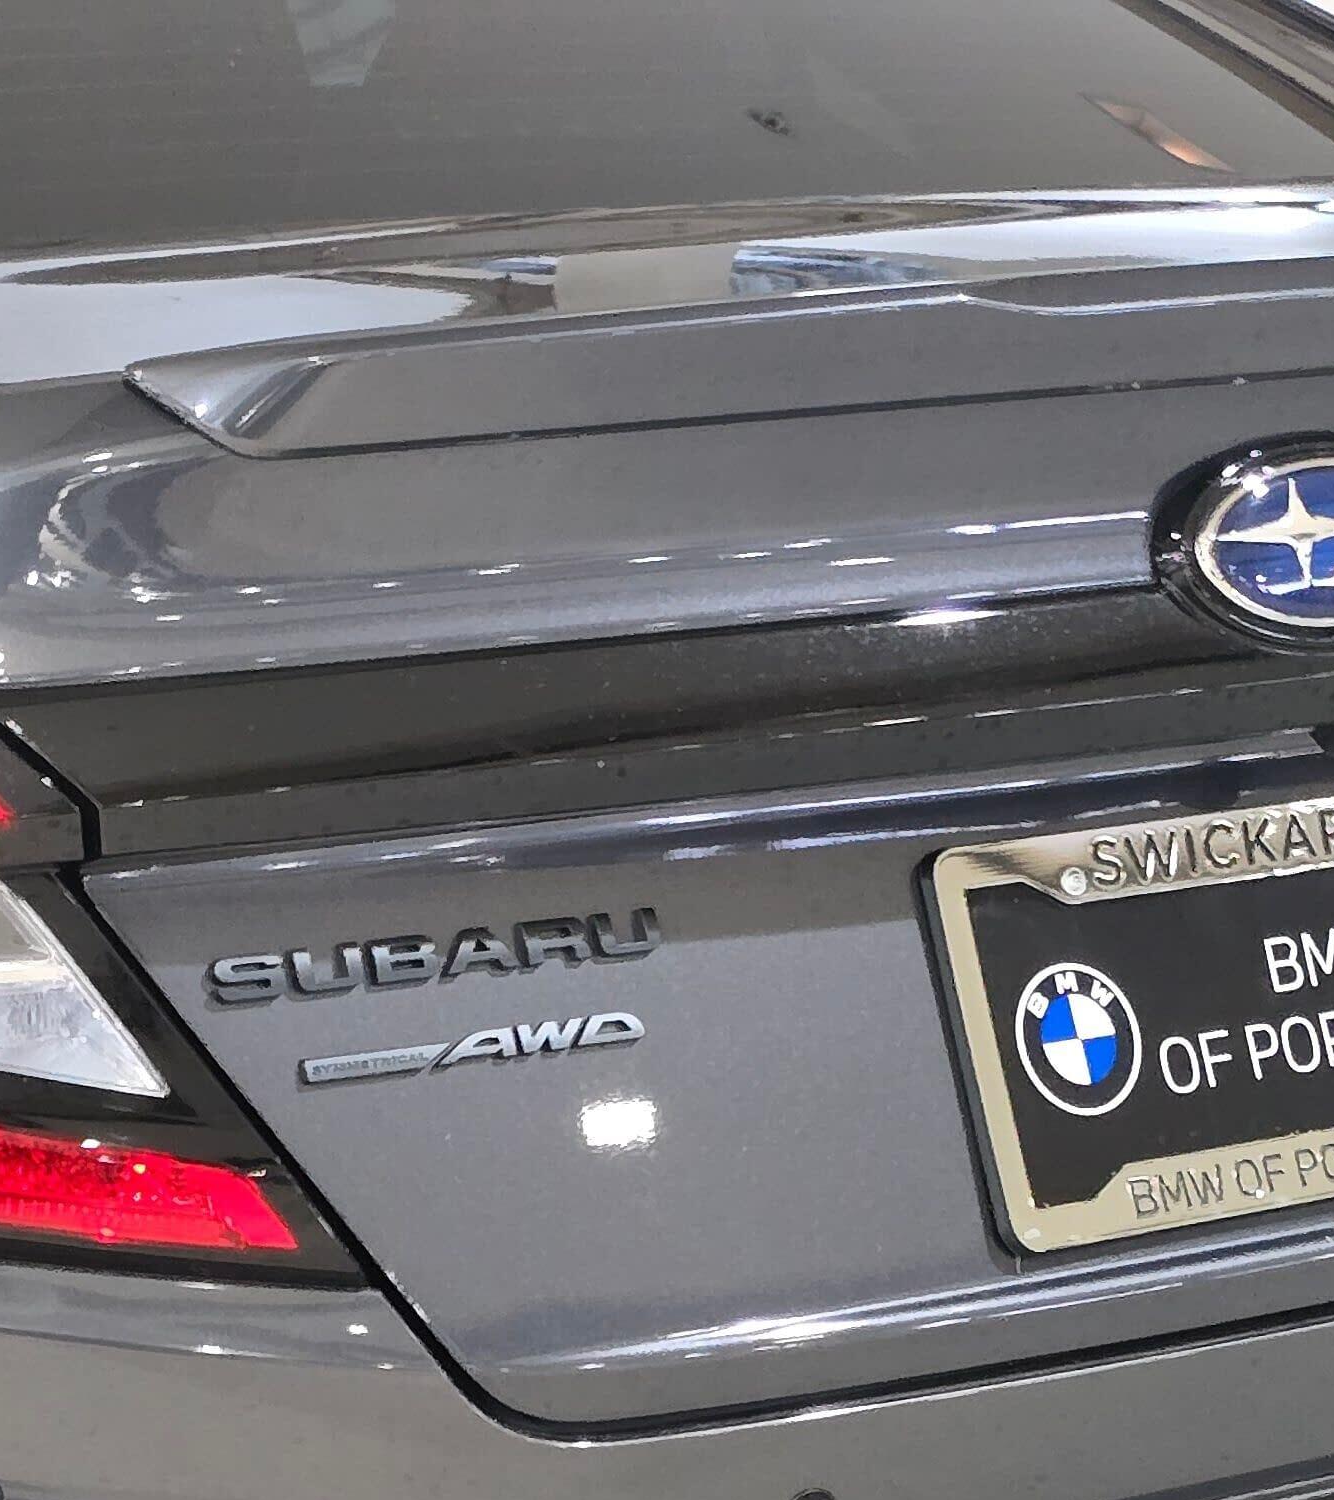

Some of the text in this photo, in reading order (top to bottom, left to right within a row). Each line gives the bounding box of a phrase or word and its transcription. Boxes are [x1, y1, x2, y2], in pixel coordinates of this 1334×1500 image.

[204, 906, 661, 1007] SUBARU
[1026, 971, 1115, 1020] BMW
[428, 1012, 646, 1075] AWD
[1158, 1029, 1234, 1095] OF
[1127, 1163, 1225, 1220] BMW
[1234, 1155, 1287, 1200] OF
